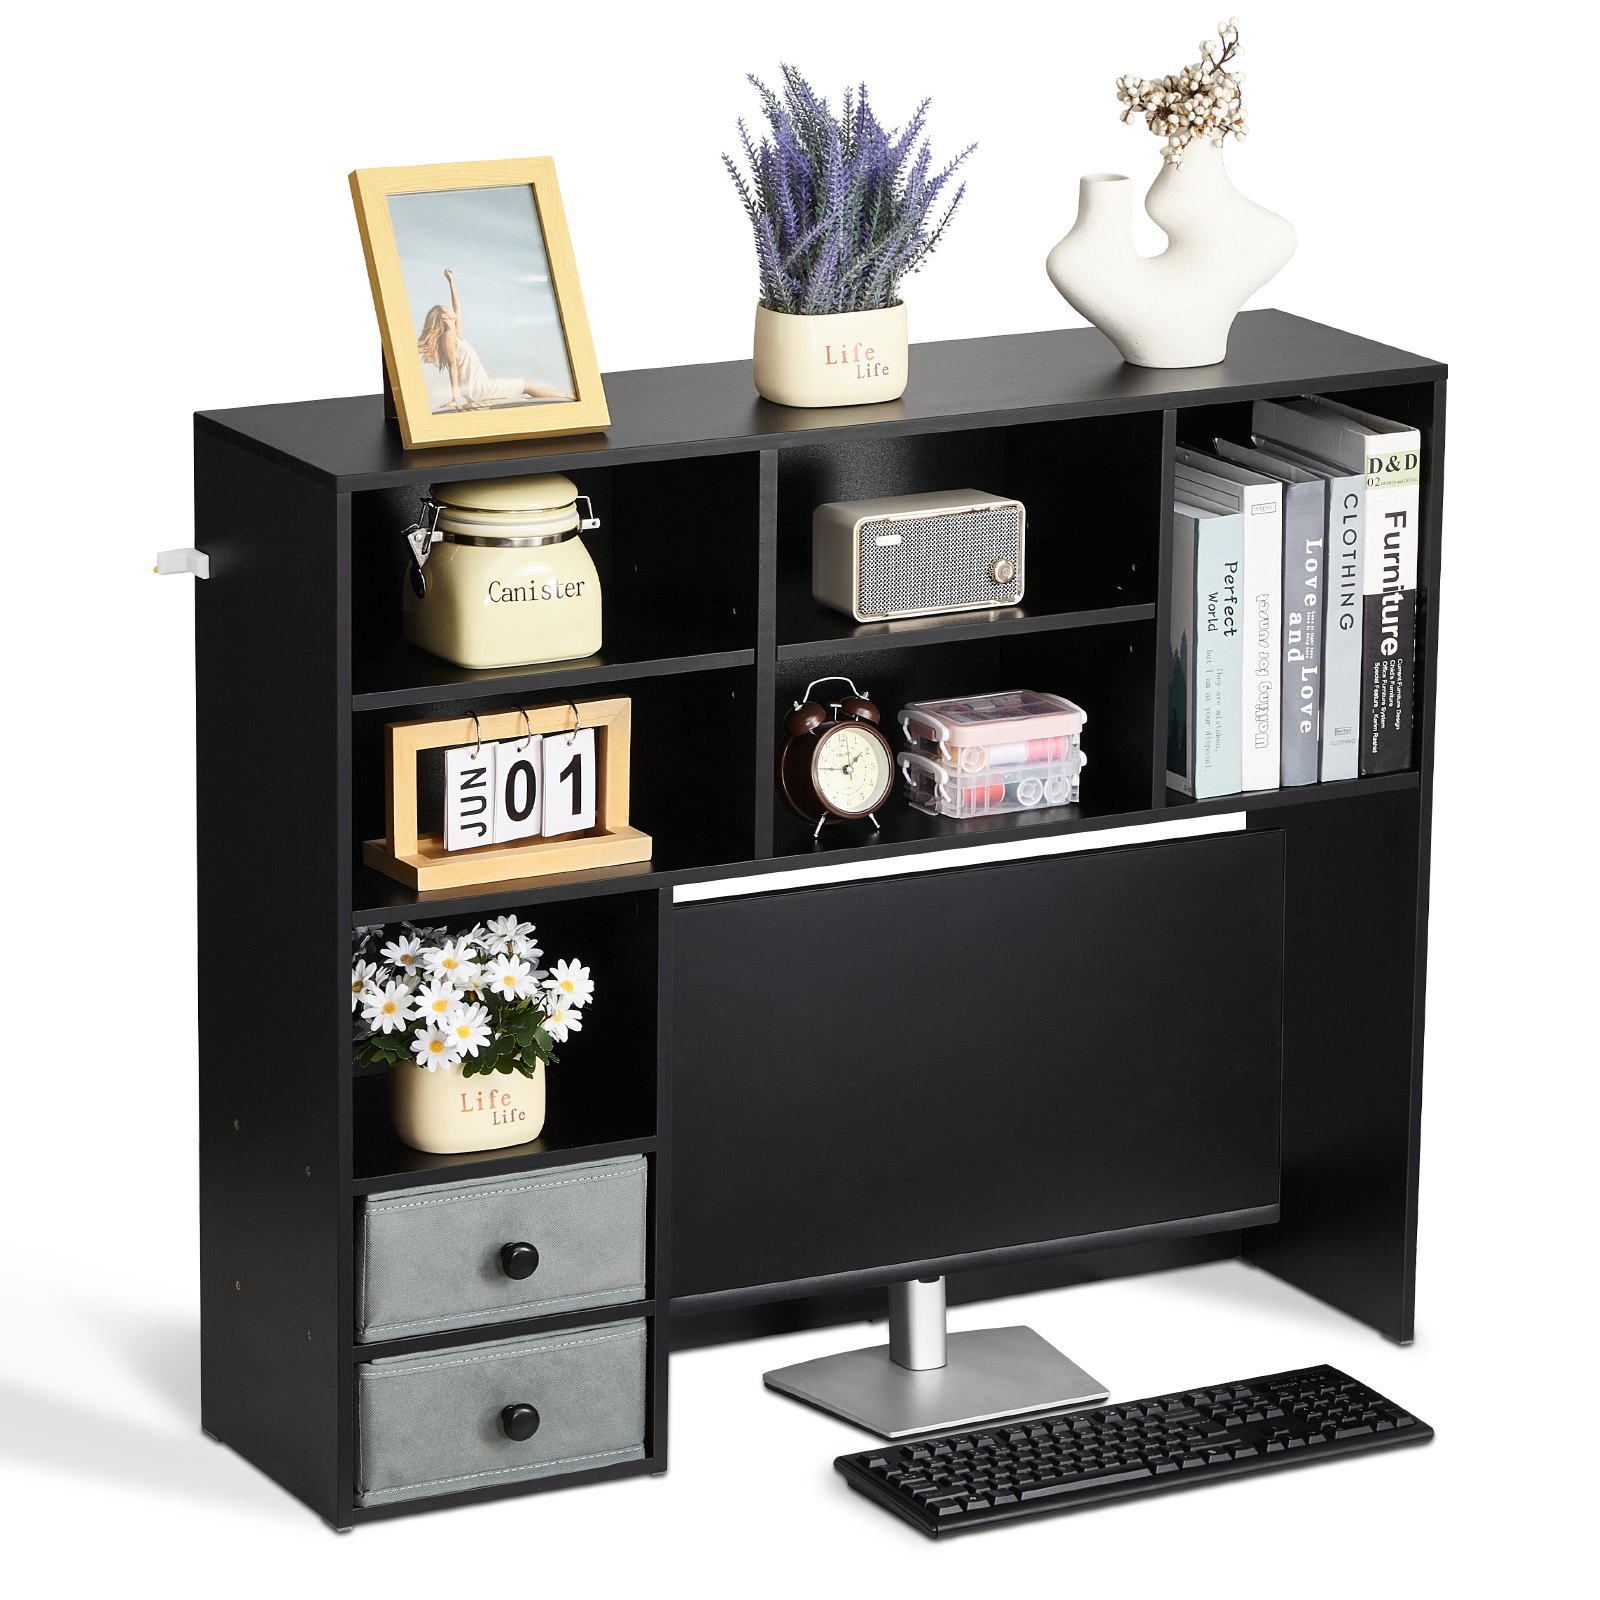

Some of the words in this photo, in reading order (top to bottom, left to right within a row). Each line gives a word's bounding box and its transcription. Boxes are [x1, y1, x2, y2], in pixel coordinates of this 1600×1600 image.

[825, 343, 875, 365] Life
[857, 363, 889, 379] Life
[1367, 477, 1380, 487] 02
[1304, 538, 1323, 607] Love
[1340, 493, 1359, 631] CLOTHING
[489, 579, 585, 603] Canister
[1380, 510, 1407, 657] Furniture
[1223, 561, 1238, 637] Perfect
[1207, 592, 1219, 632] World
[1256, 593, 1269, 648] sunset
[1287, 612, 1304, 663] and
[1255, 651, 1269, 676] for
[1205, 679, 1211, 688] am
[1215, 667, 1223, 687] They
[1205, 692, 1212, 702] at
[1300, 665, 1318, 734] Love
[1204, 707, 1212, 726] your
[1255, 681, 1272, 749] Waiting
[1394, 709, 1402, 730] Design
[460, 766, 487, 837] JUN
[460, 1089, 511, 1113] Life
[493, 1108, 526, 1125] Life
